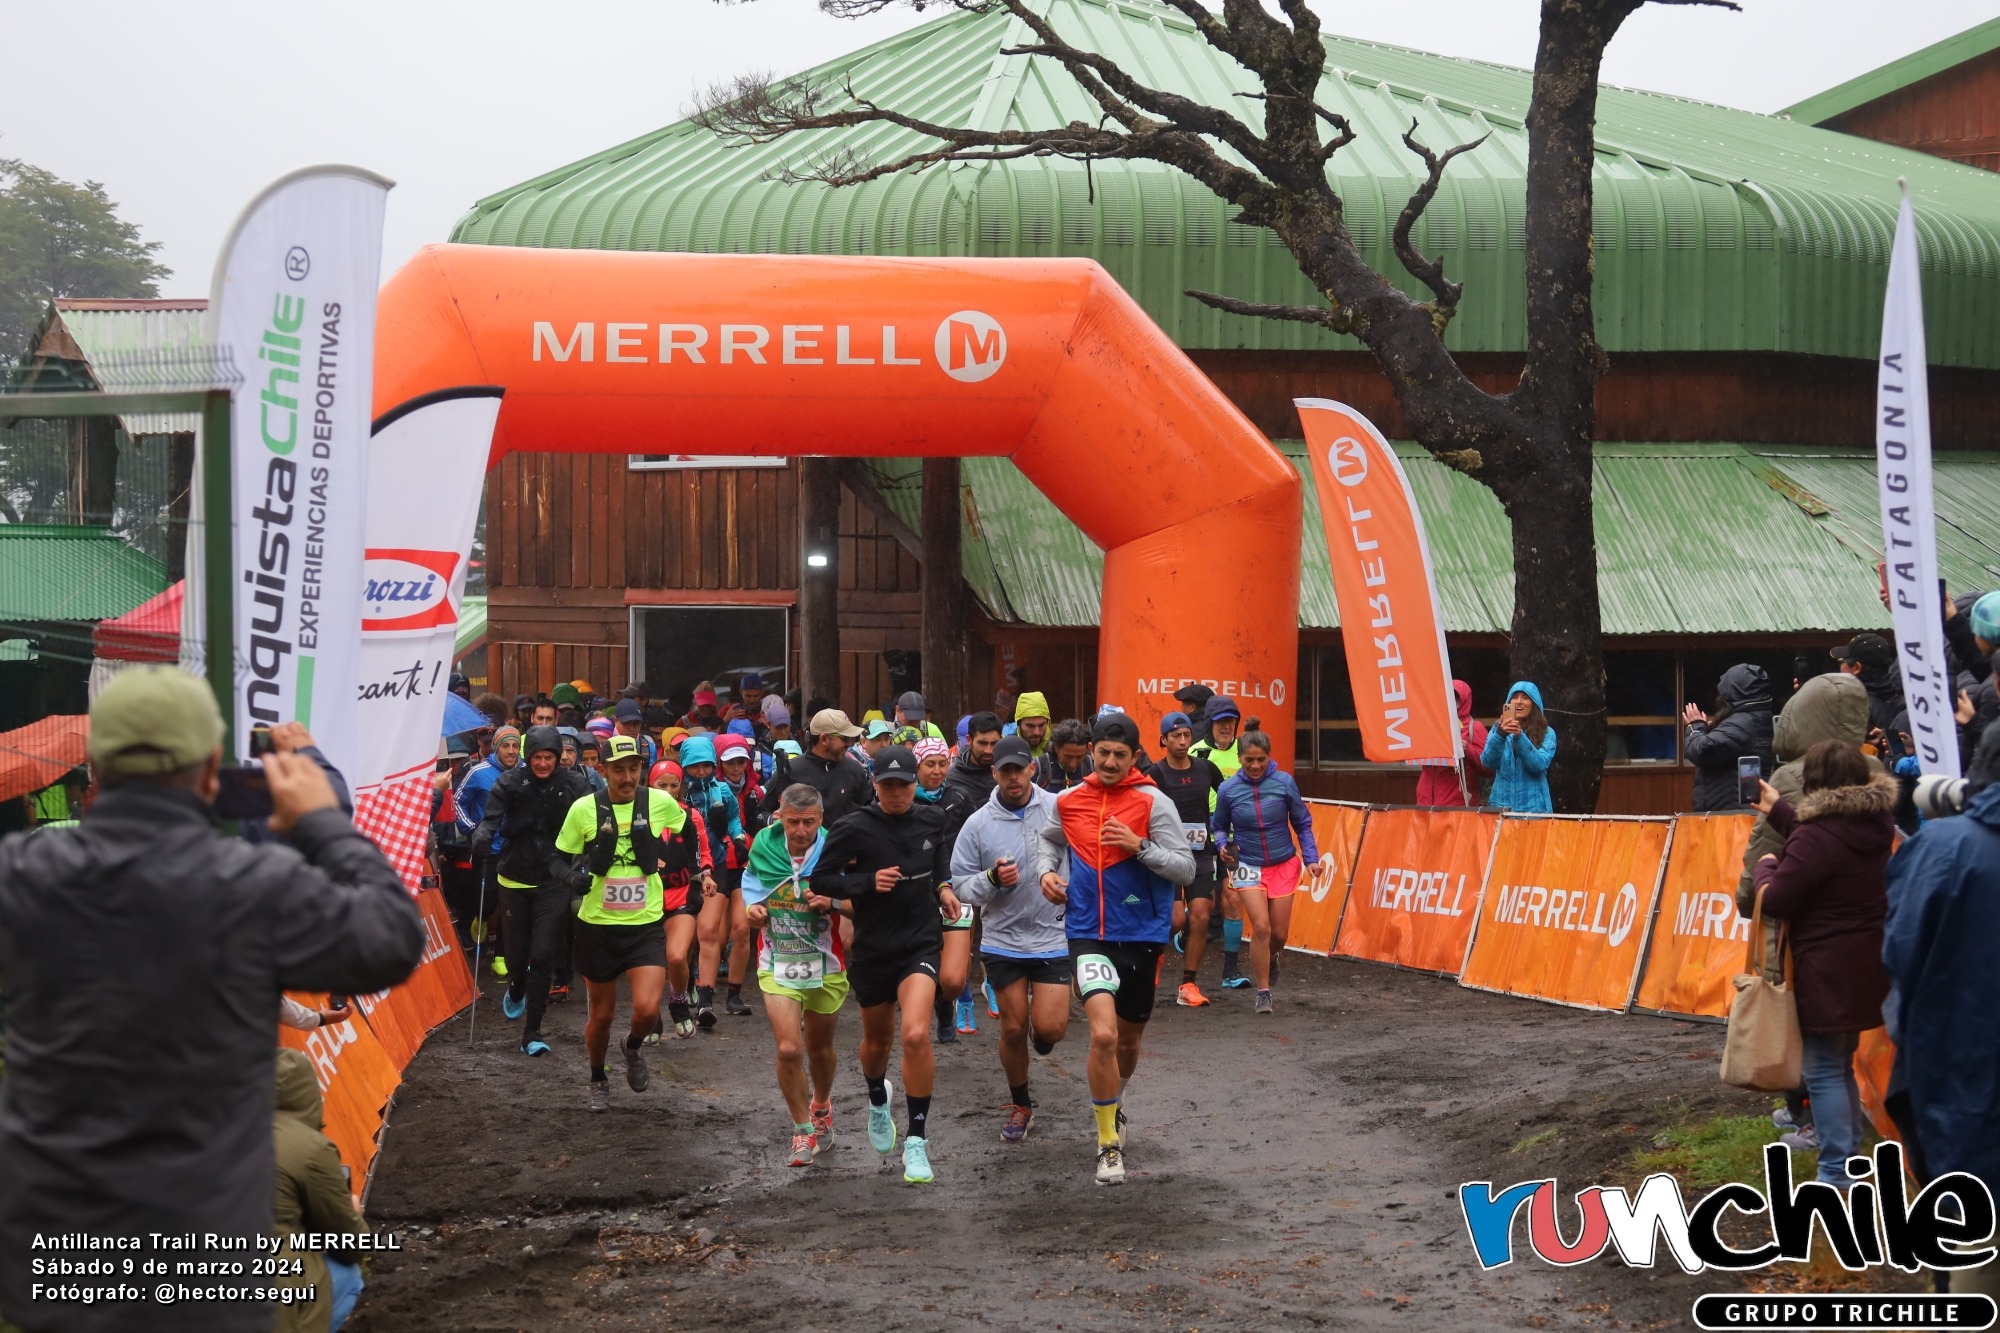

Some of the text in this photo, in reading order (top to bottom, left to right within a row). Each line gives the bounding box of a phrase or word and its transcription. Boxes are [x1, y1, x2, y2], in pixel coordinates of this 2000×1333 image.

[532, 321, 921, 366] MERRELL
[298, 302, 341, 650] EXPERIENCIAS DEPORTIVAS
[244, 292, 305, 733] nquistaChile
[1883, 351, 1939, 764] UISTA PATAGONIA
[363, 573, 437, 601] rozzi
[1186, 829, 1206, 844] 45
[604, 884, 646, 903] 305
[1369, 867, 1467, 918] MERRELL
[1494, 884, 1608, 934] MERRELL
[1673, 891, 1752, 942] MERR
[784, 961, 813, 980] 63
[1084, 962, 1113, 982] 50
